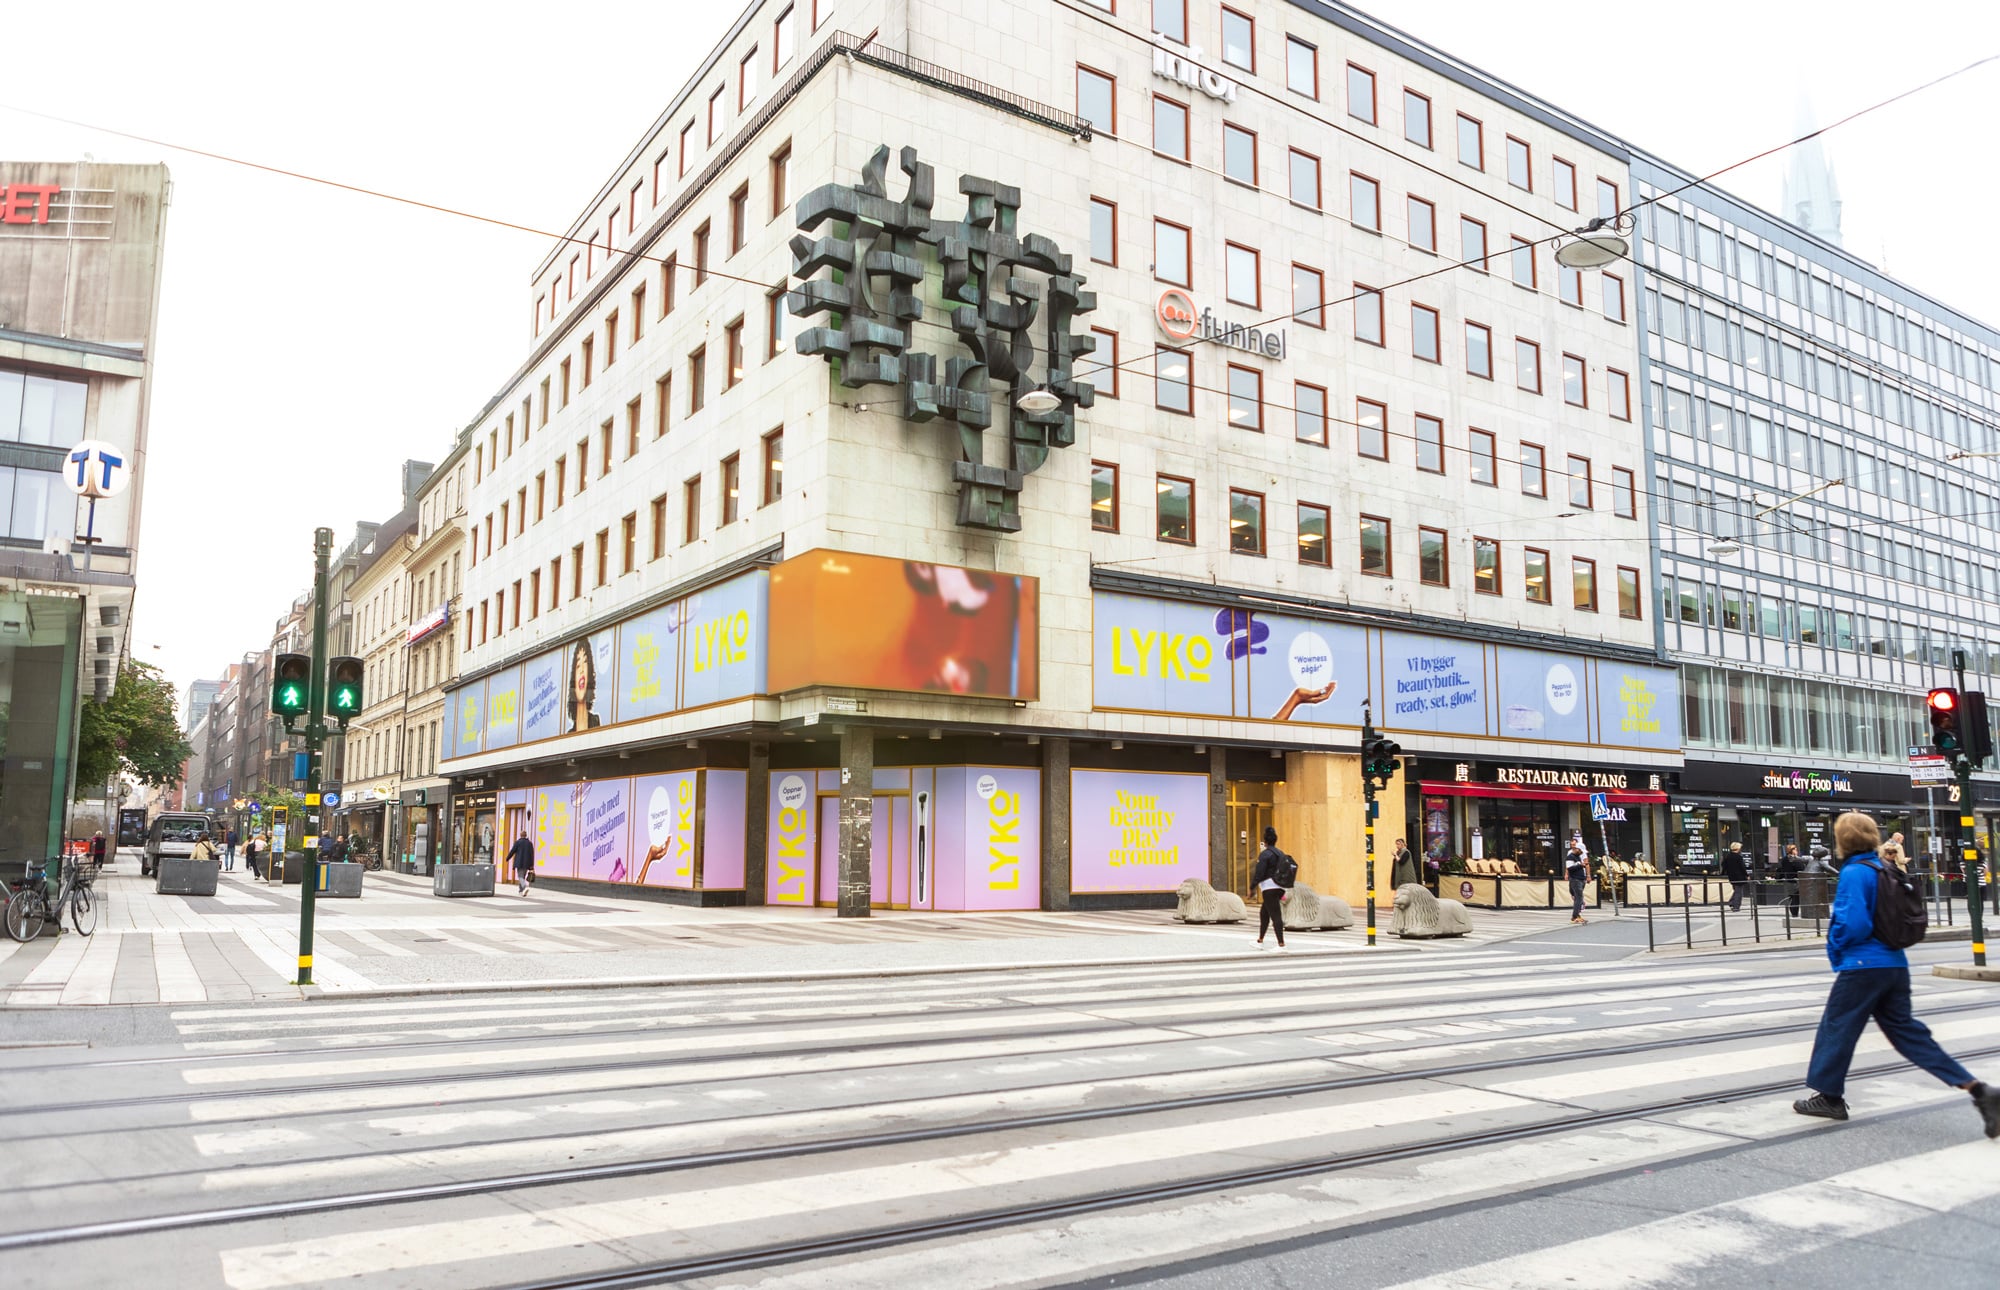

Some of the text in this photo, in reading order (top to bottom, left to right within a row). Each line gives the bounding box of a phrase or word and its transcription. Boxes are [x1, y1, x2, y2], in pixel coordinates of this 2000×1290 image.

[1151, 33, 1243, 104] infor
[0, 184, 61, 225] ET
[1200, 307, 1286, 360] funnel
[71, 449, 89, 487] T
[99, 451, 122, 489] T
[694, 609, 749, 673] LYKO
[1111, 625, 1214, 684] LYKO
[1407, 655, 1456, 673] Vi bygger
[1397, 673, 1470, 693] beautybutik...
[1395, 690, 1477, 714] ready, set, glow!
[1213, 784, 1223, 794] 23
[1496, 768, 1628, 789] RESTAURANG TANG
[1763, 775, 1853, 792] STHLM CITY FOOD HALL
[1949, 785, 1960, 802] 29
[1115, 790, 1160, 811] Your
[675, 779, 693, 877] LYKO
[1109, 806, 1175, 832] beauty
[777, 806, 807, 902] LYKO
[988, 789, 1020, 891] LYKO
[1109, 845, 1179, 868] ground
